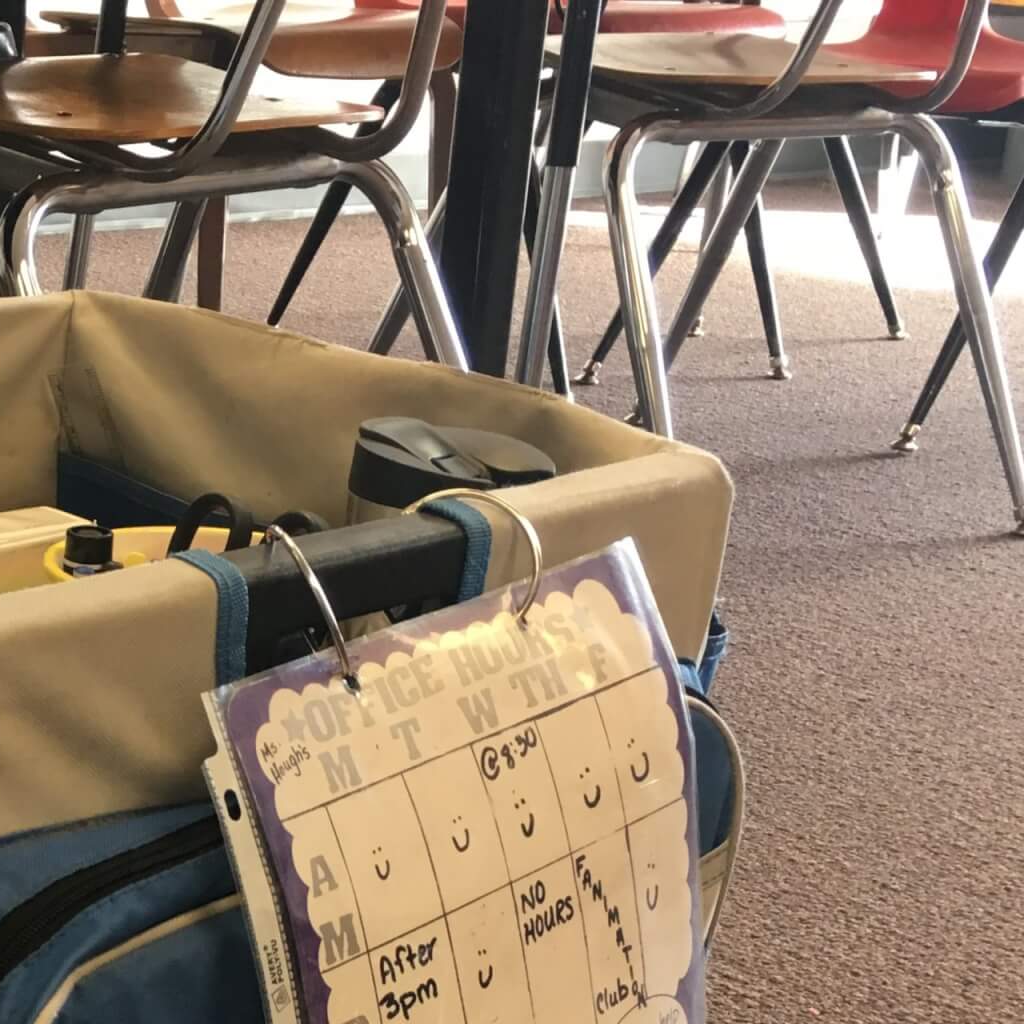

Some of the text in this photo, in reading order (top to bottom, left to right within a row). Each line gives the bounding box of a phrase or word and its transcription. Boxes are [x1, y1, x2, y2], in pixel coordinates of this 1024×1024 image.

[303, 613, 576, 743] OFFICE HOURS
[317, 642, 610, 794] M T W TH F
[520, 880, 546, 914] NO
[523, 896, 574, 945] HOURS
[379, 936, 437, 985] After
[378, 977, 438, 1020] 3pm
[596, 977, 629, 1015] Club
